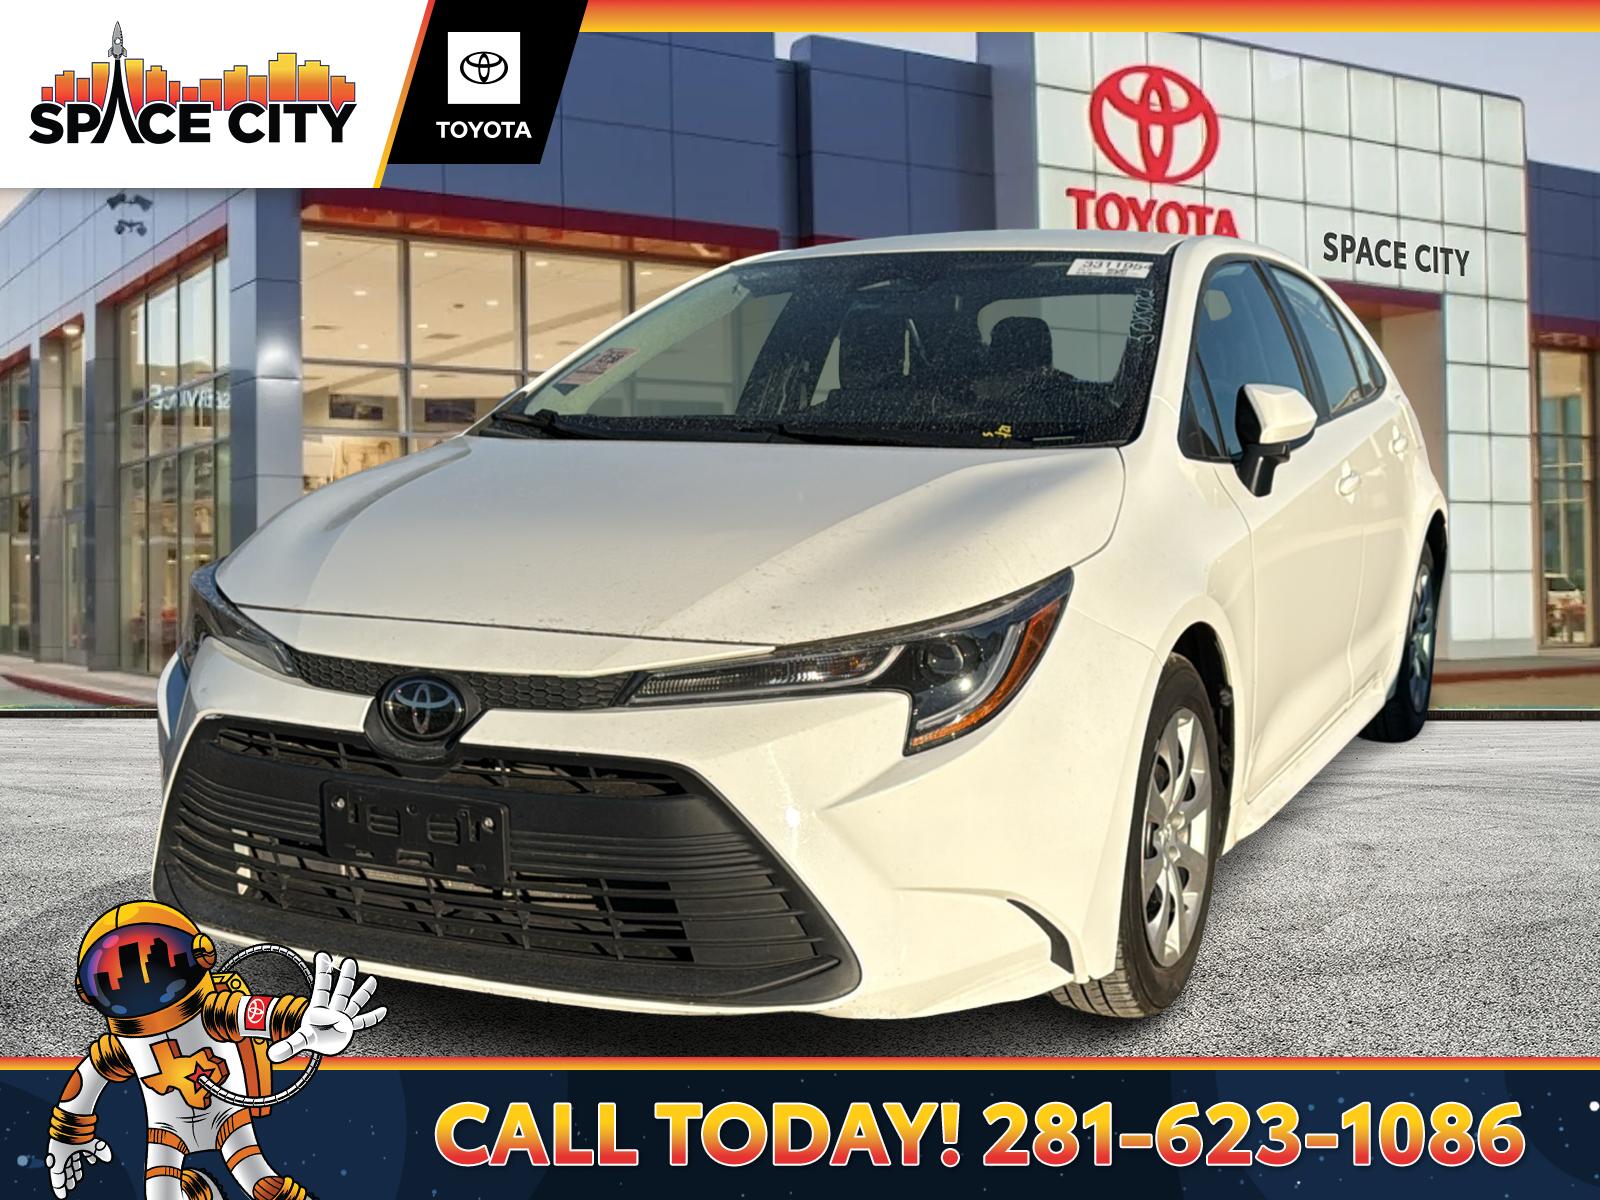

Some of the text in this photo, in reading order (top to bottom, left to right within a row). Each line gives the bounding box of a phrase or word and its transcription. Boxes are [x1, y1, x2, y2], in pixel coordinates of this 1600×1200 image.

[1065, 188, 1239, 239] TOYOTA
[1323, 232, 1470, 277] SPACE CITY
